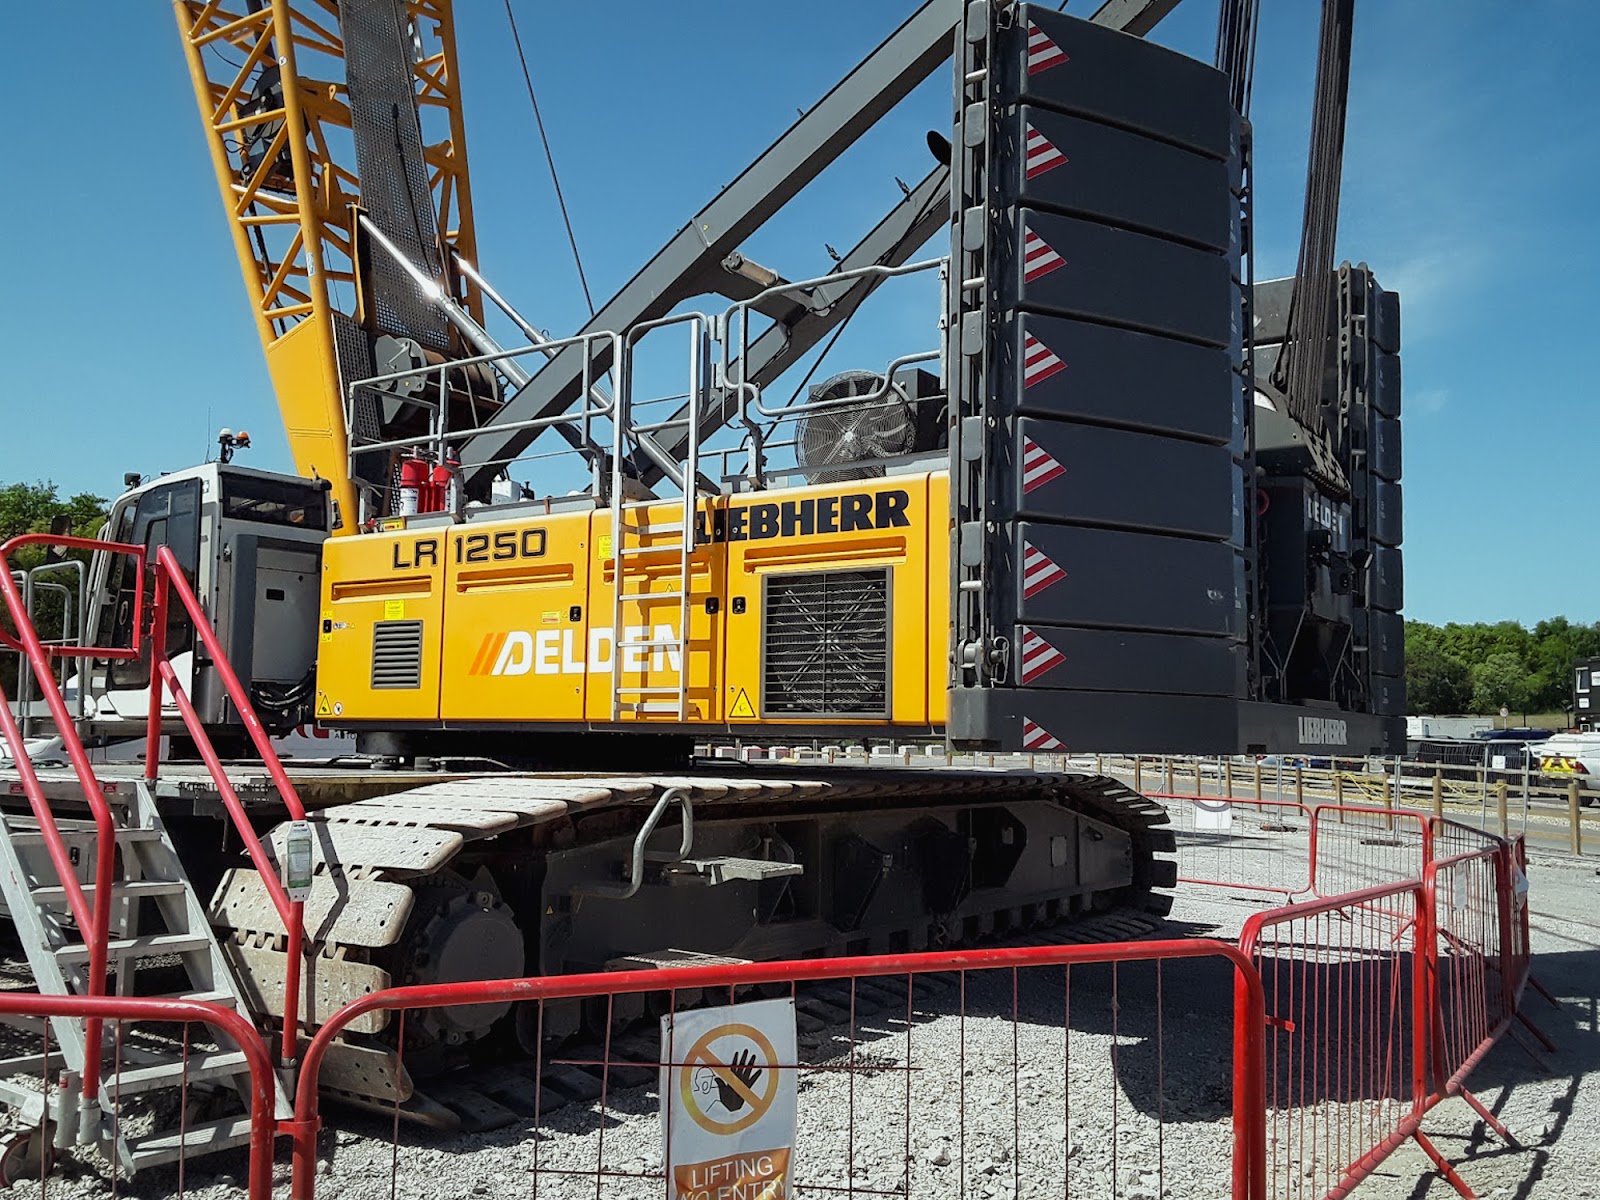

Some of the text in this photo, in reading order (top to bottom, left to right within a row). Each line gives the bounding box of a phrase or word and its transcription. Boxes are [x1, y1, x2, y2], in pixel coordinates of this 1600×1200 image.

[696, 489, 911, 544] LIEBHERR
[392, 528, 548, 570] LR 1250
[491, 623, 683, 676] DELDEN
[1298, 716, 1348, 746] LIEBHERR
[692, 1156, 774, 1189] LIFTING
